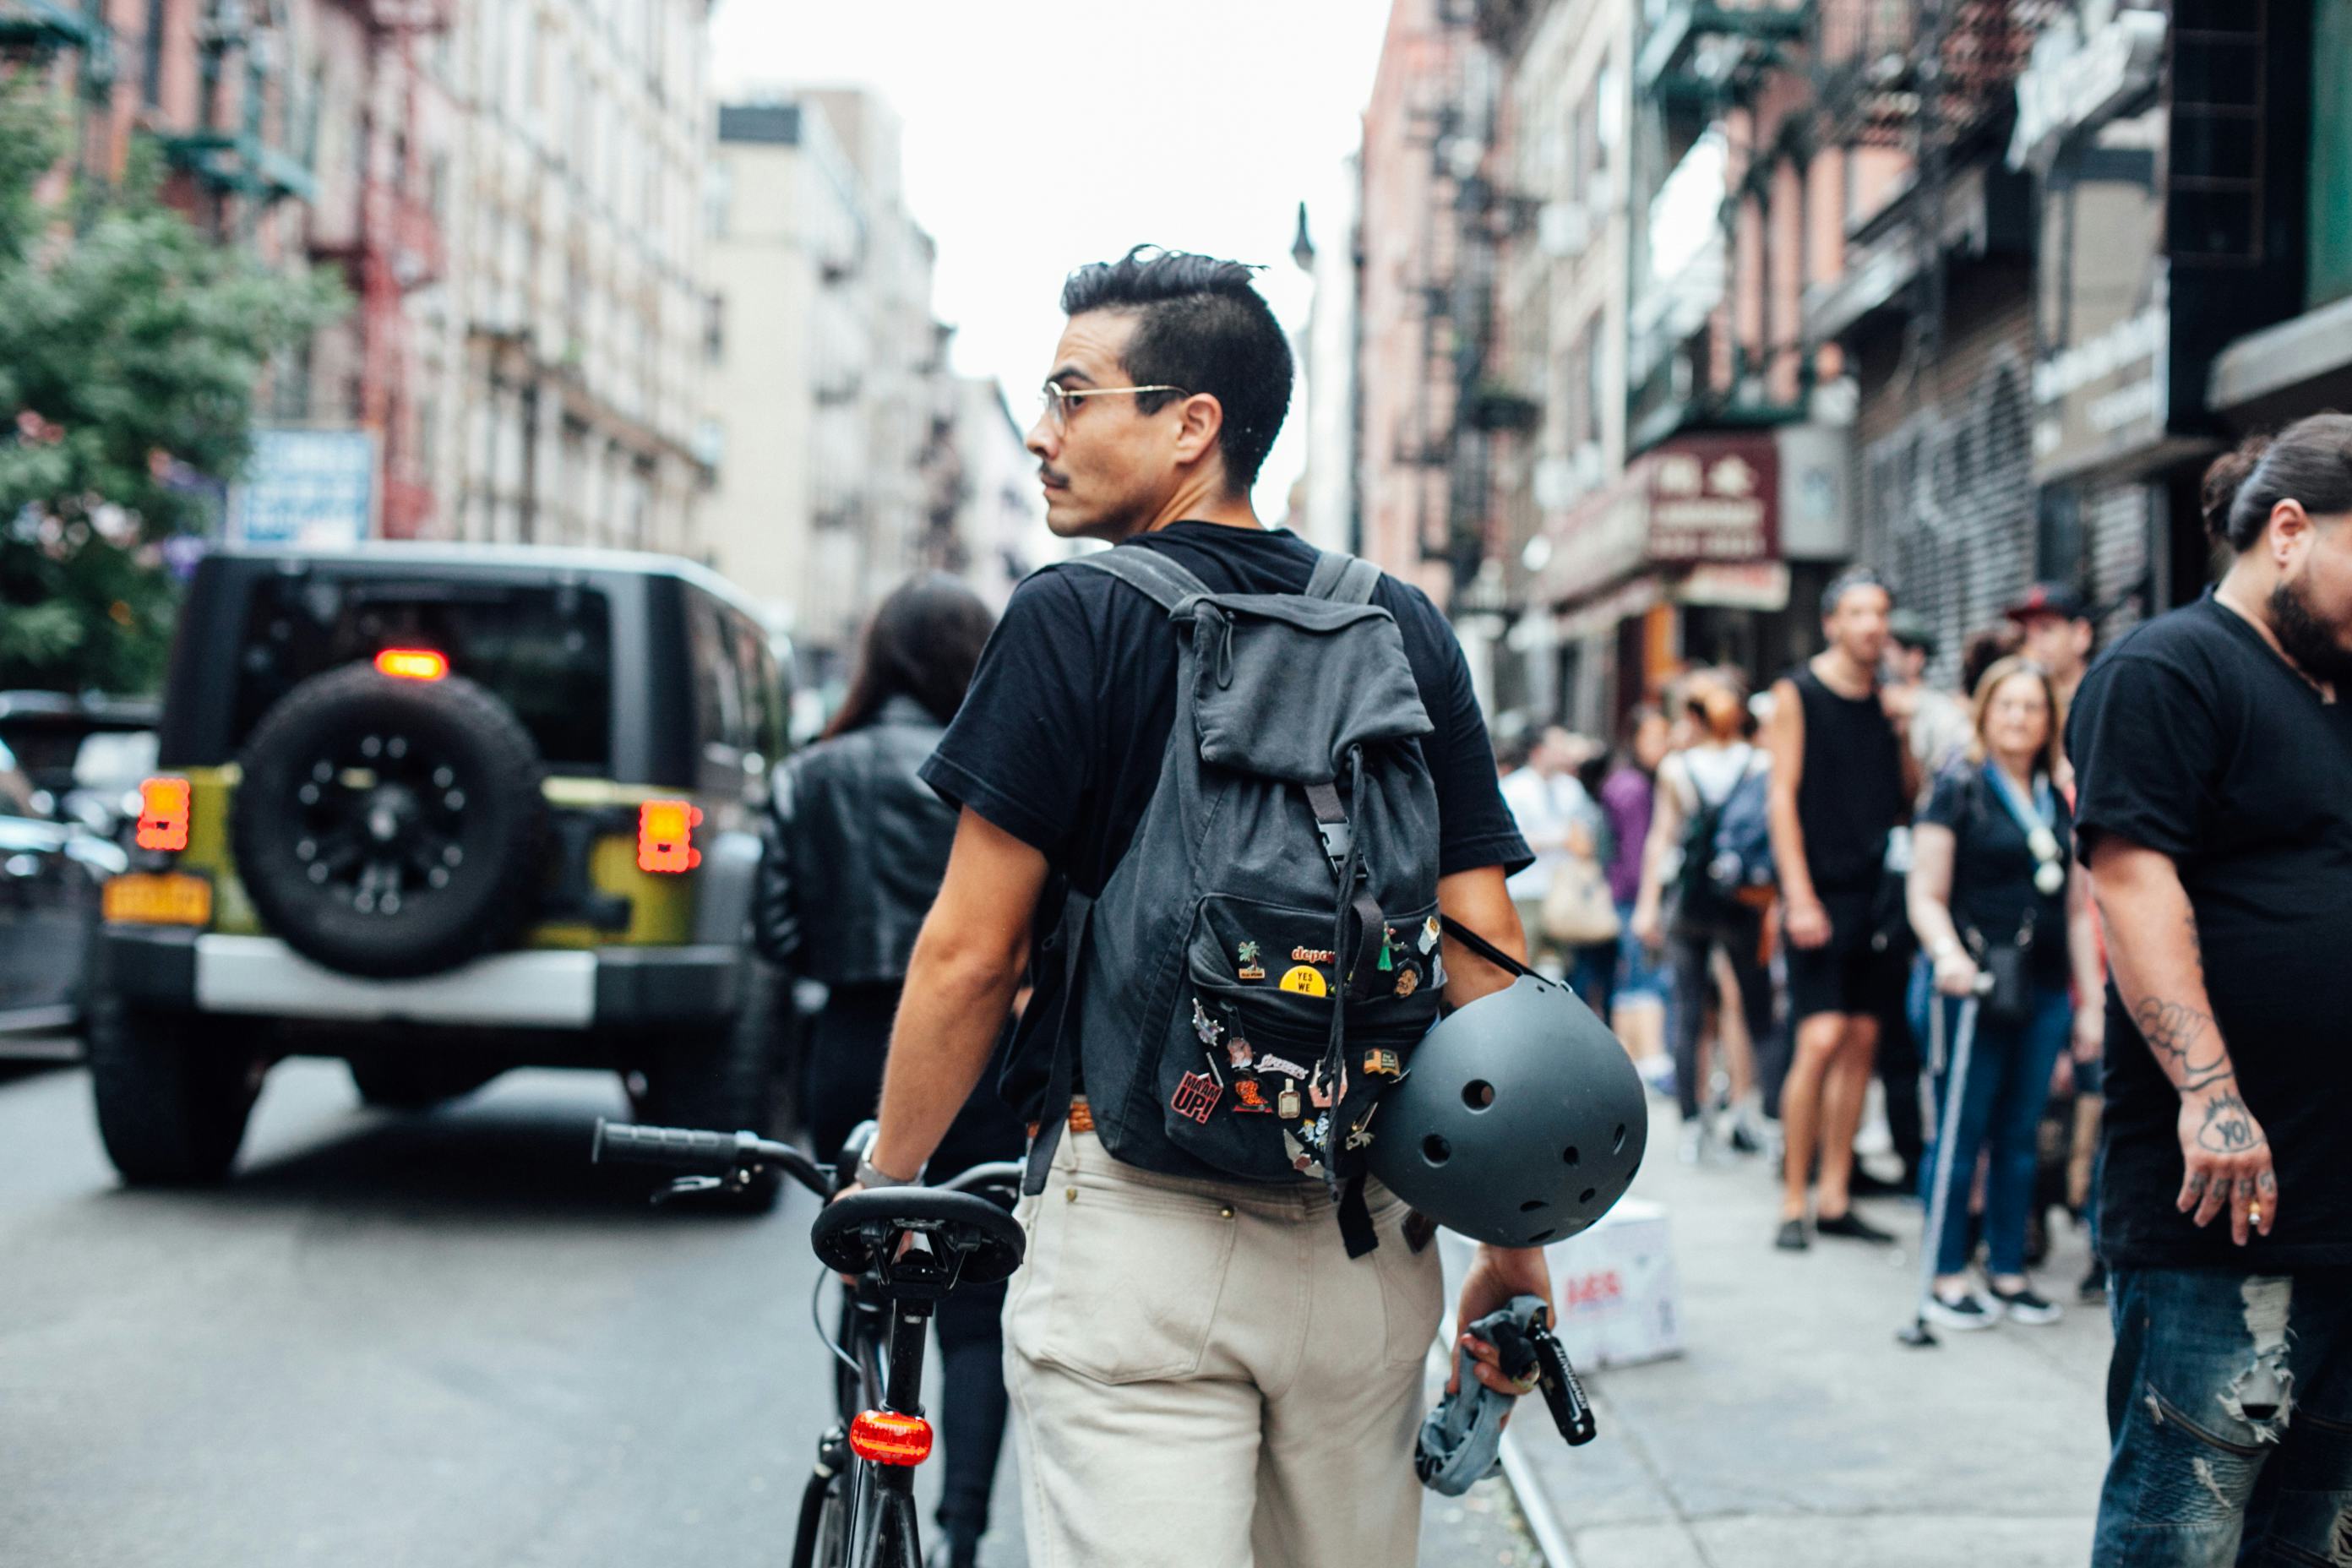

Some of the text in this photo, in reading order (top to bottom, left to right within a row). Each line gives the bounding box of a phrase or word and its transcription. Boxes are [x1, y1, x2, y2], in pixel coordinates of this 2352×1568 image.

[1298, 972, 1313, 982] YES
[1298, 983, 1310, 992] WE
[1174, 1086, 1214, 1121] UP!
